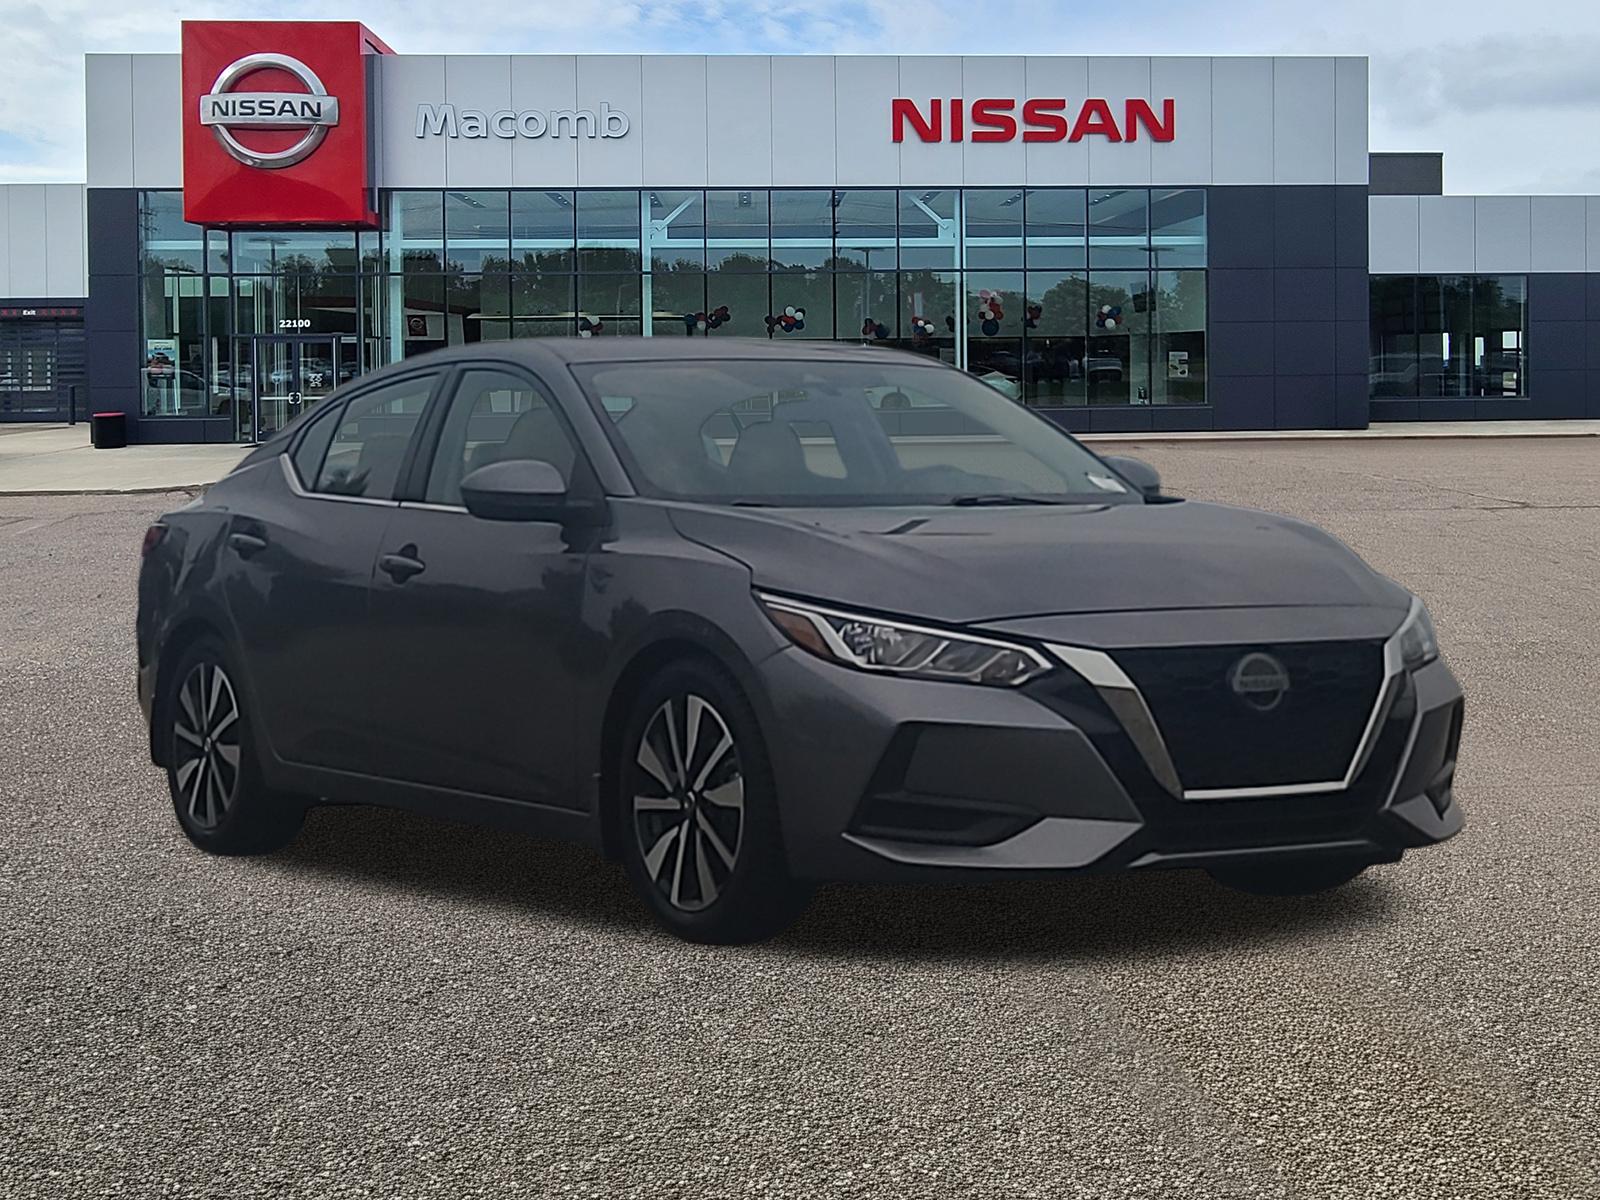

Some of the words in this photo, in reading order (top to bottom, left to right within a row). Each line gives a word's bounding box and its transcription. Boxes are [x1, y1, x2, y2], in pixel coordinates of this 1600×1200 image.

[212, 100, 322, 117] NISSAN
[415, 102, 629, 138] Macomb
[892, 98, 1175, 143] NISSAN
[279, 319, 312, 328] 22100
